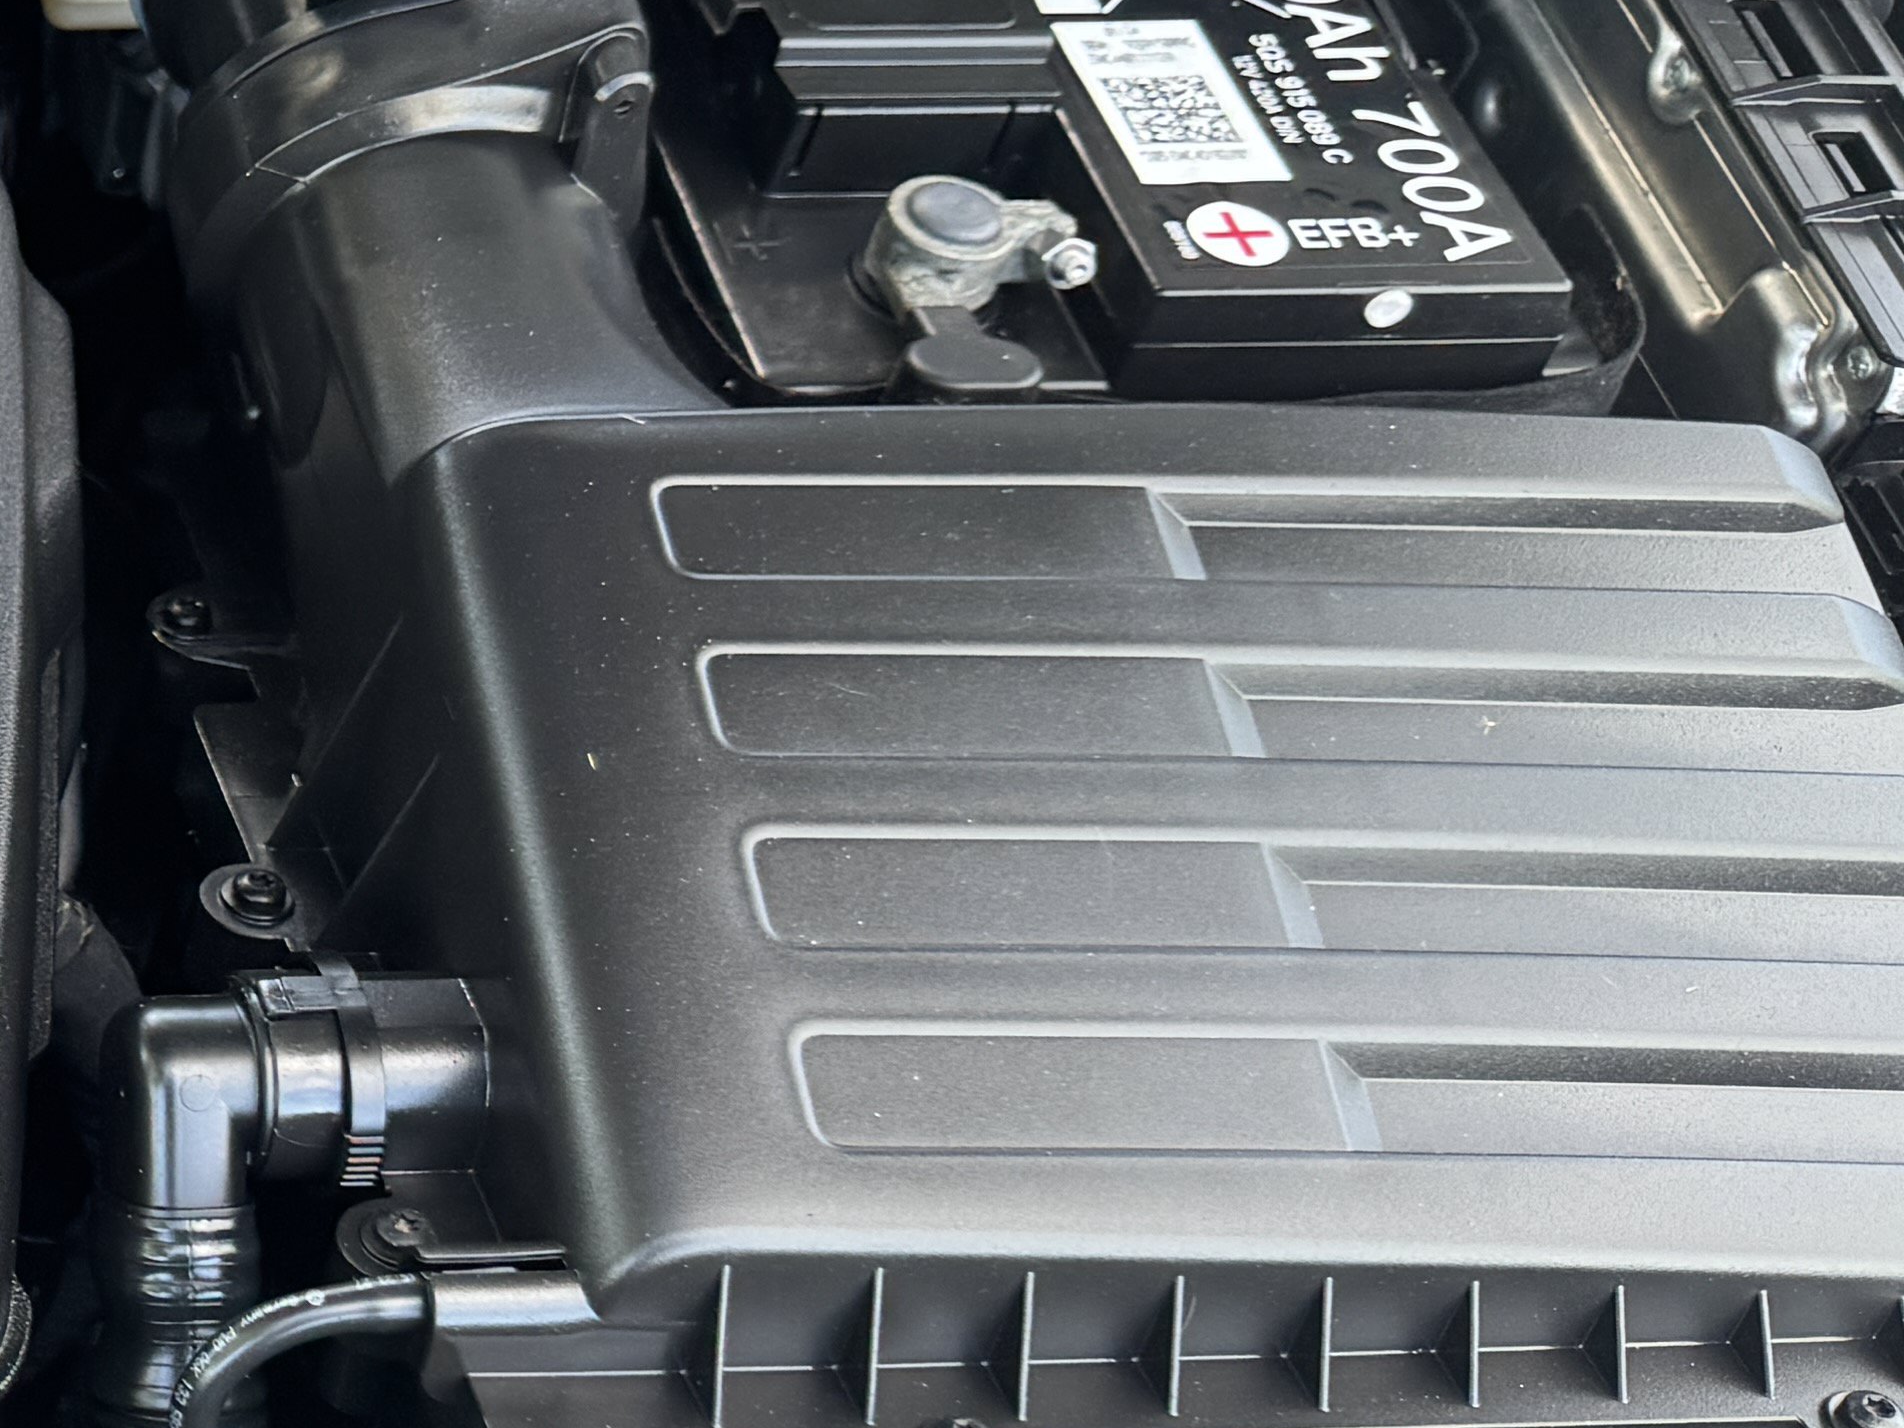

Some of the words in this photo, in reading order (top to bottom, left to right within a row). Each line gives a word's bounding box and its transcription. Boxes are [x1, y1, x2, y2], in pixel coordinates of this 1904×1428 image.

[1270, 115, 1306, 144] DIN
[1274, 75, 1317, 108] 915
[1297, 109, 1342, 145] 089
[1322, 148, 1354, 164] C
[1351, 101, 1513, 262] 700A
[1288, 217, 1420, 249] EFB+
